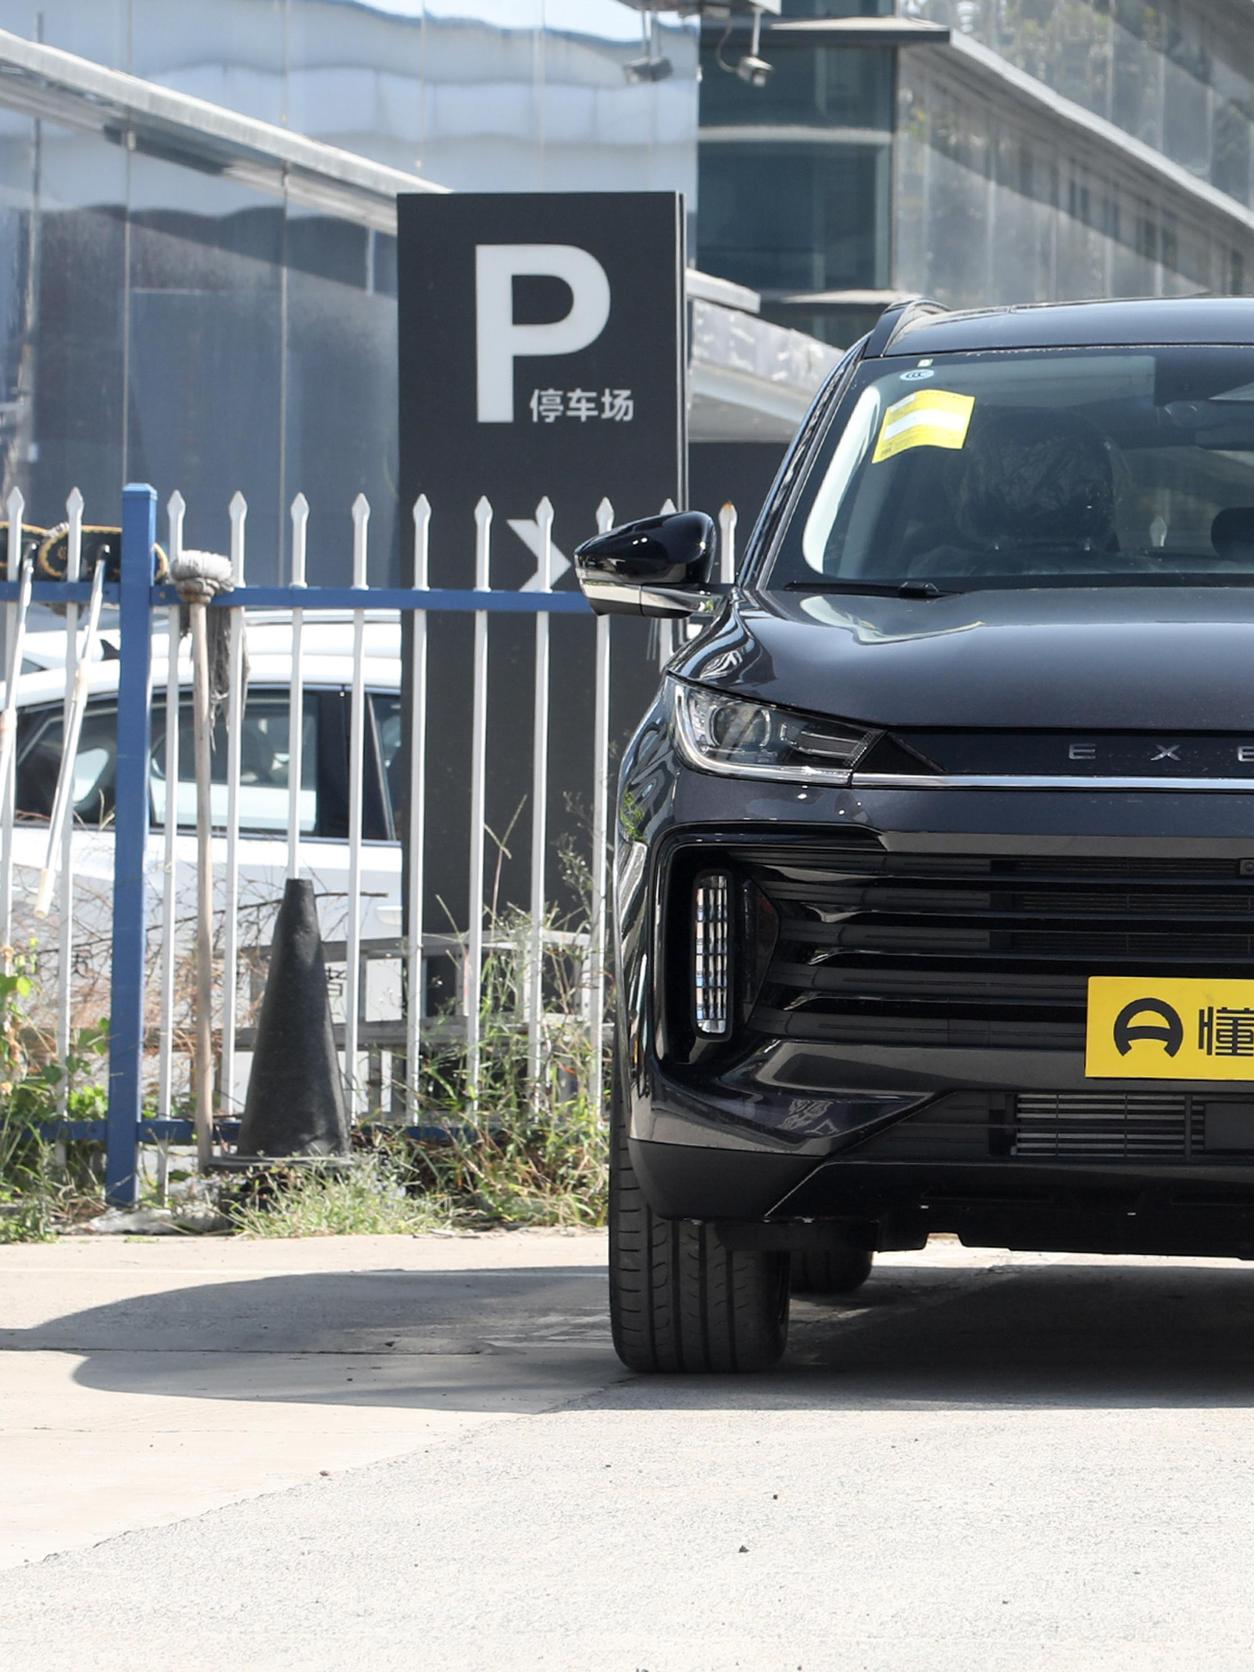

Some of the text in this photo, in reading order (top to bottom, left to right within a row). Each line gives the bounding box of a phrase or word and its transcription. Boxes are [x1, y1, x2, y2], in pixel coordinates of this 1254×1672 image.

[475, 244, 611, 423] P
[529, 388, 635, 423] 停车场
